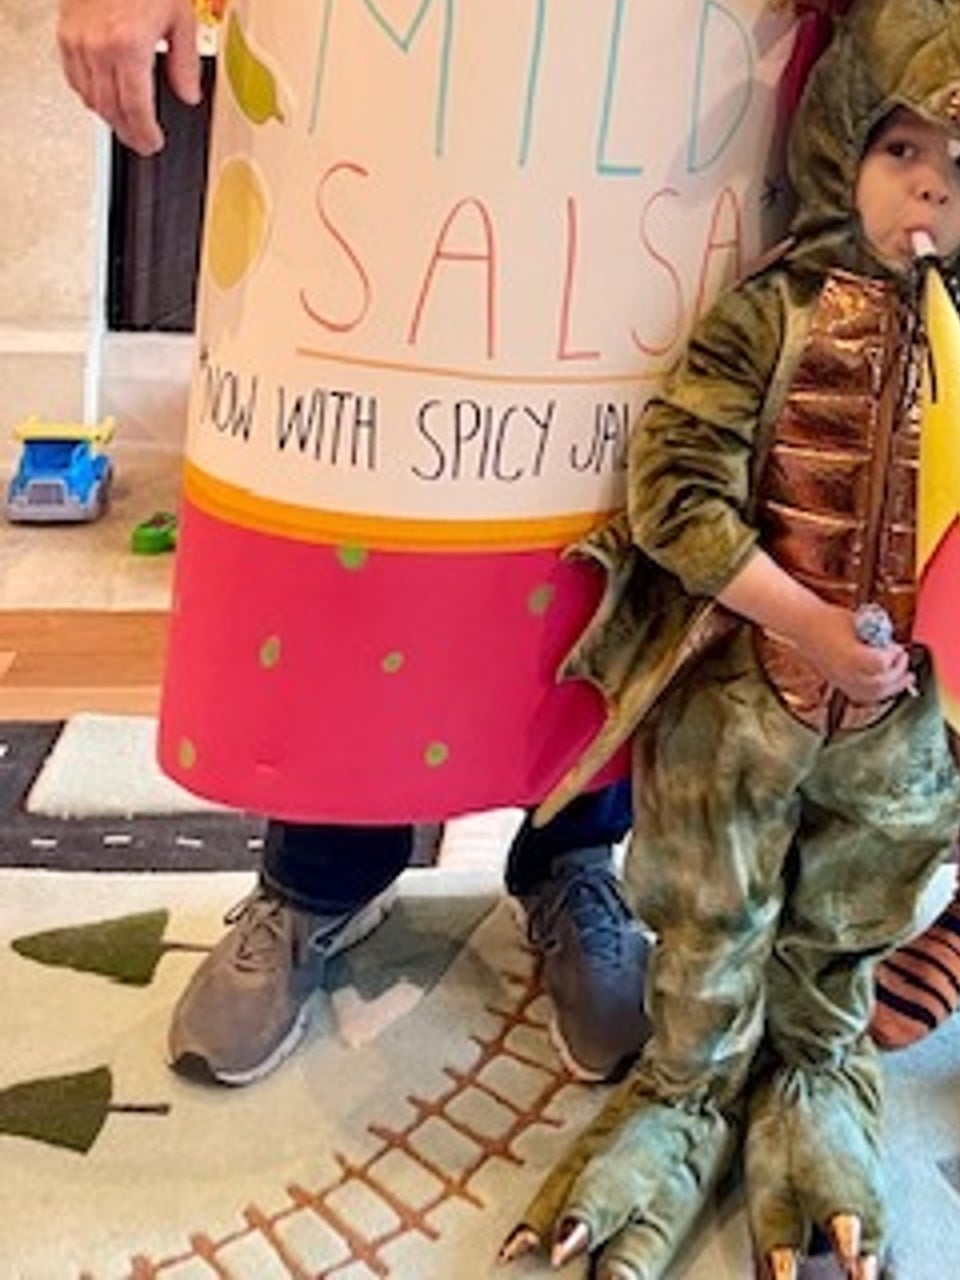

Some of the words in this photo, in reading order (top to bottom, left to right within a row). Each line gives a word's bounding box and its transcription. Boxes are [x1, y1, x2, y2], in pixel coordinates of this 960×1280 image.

[299, 160, 742, 362] SALSA
[277, 385, 377, 469] WITH
[411, 398, 558, 481] SPICY
